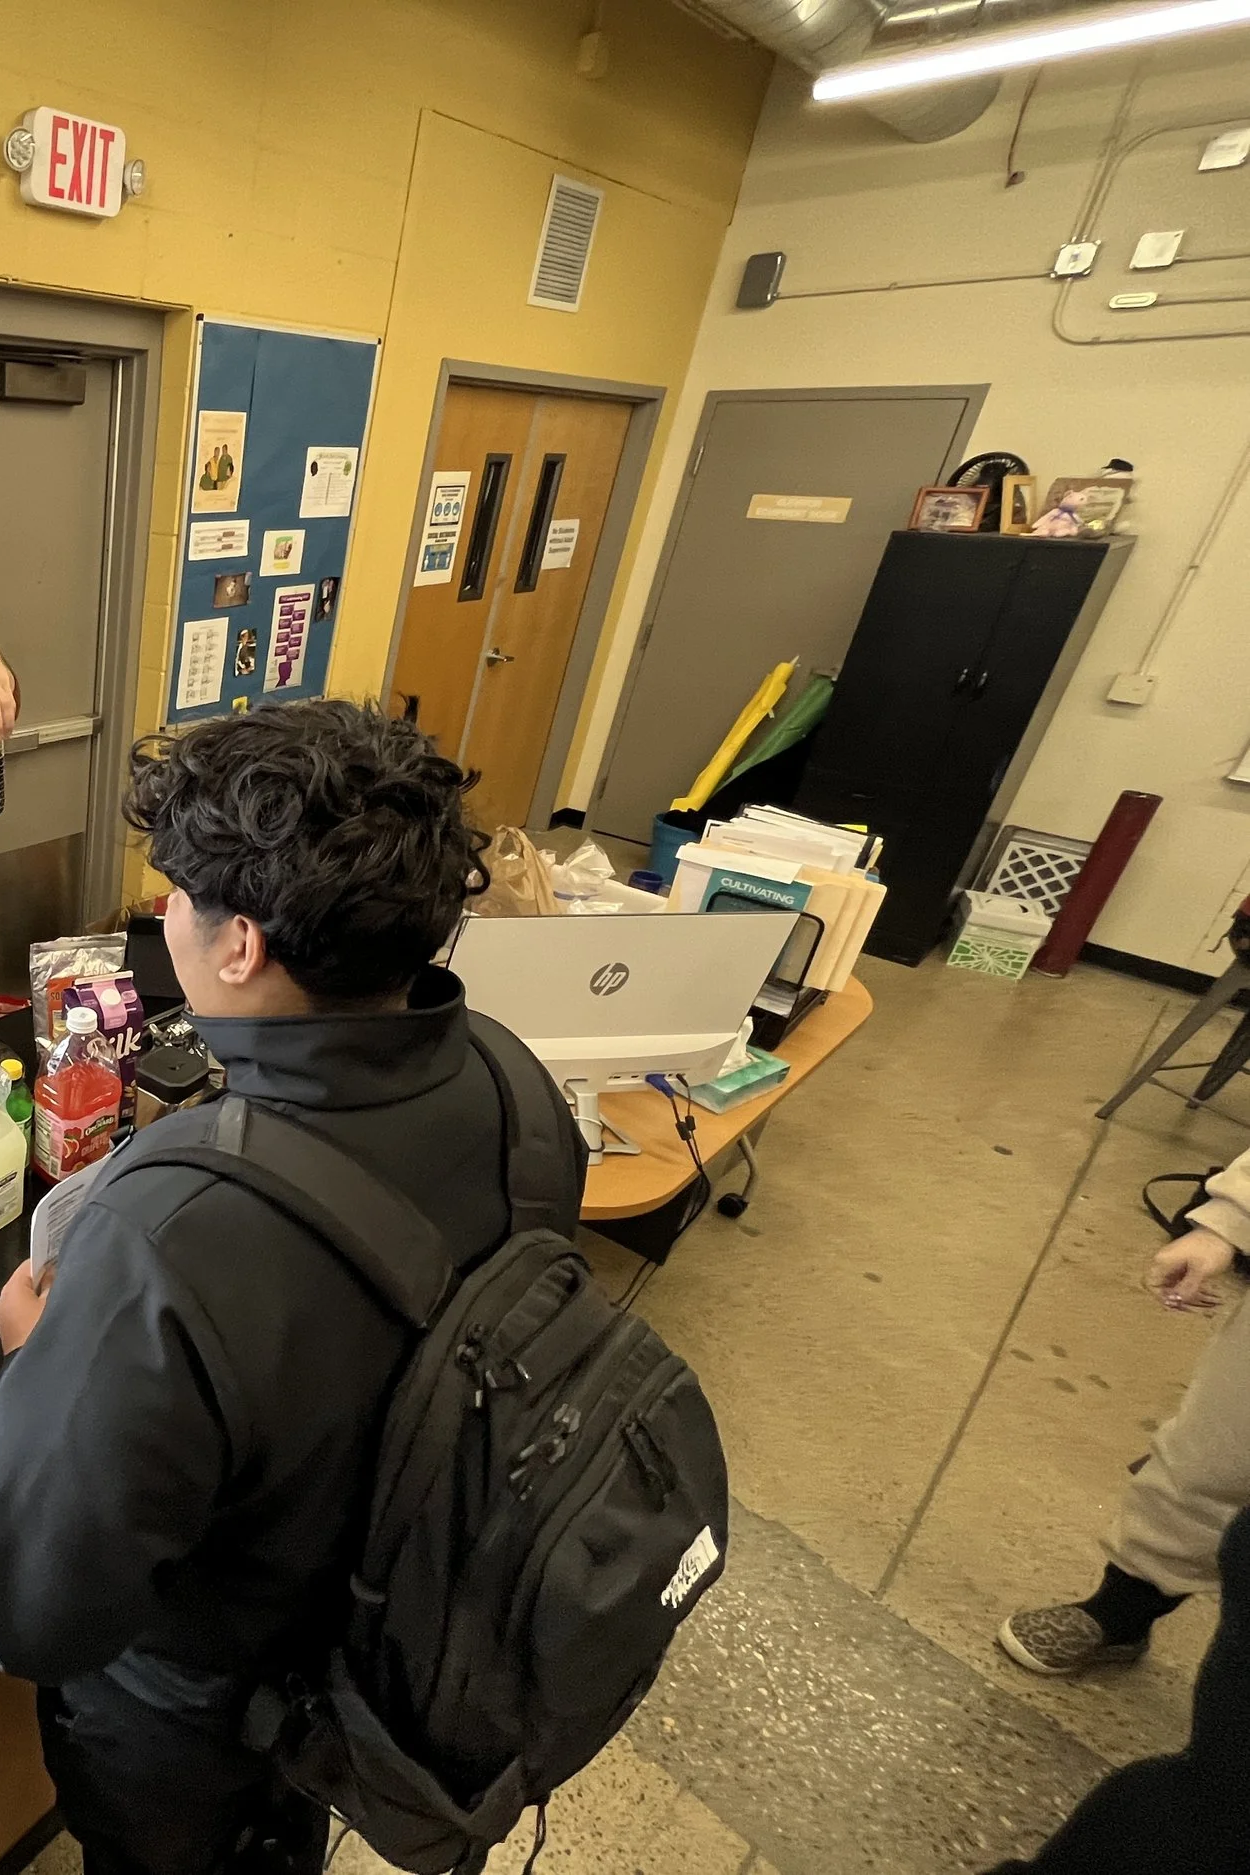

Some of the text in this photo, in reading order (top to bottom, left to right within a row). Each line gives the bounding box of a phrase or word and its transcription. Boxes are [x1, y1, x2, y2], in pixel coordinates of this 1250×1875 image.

[49, 115, 116, 208] EXIT
[720, 877, 795, 905] CULTIVATING
[591, 962, 628, 996] hp
